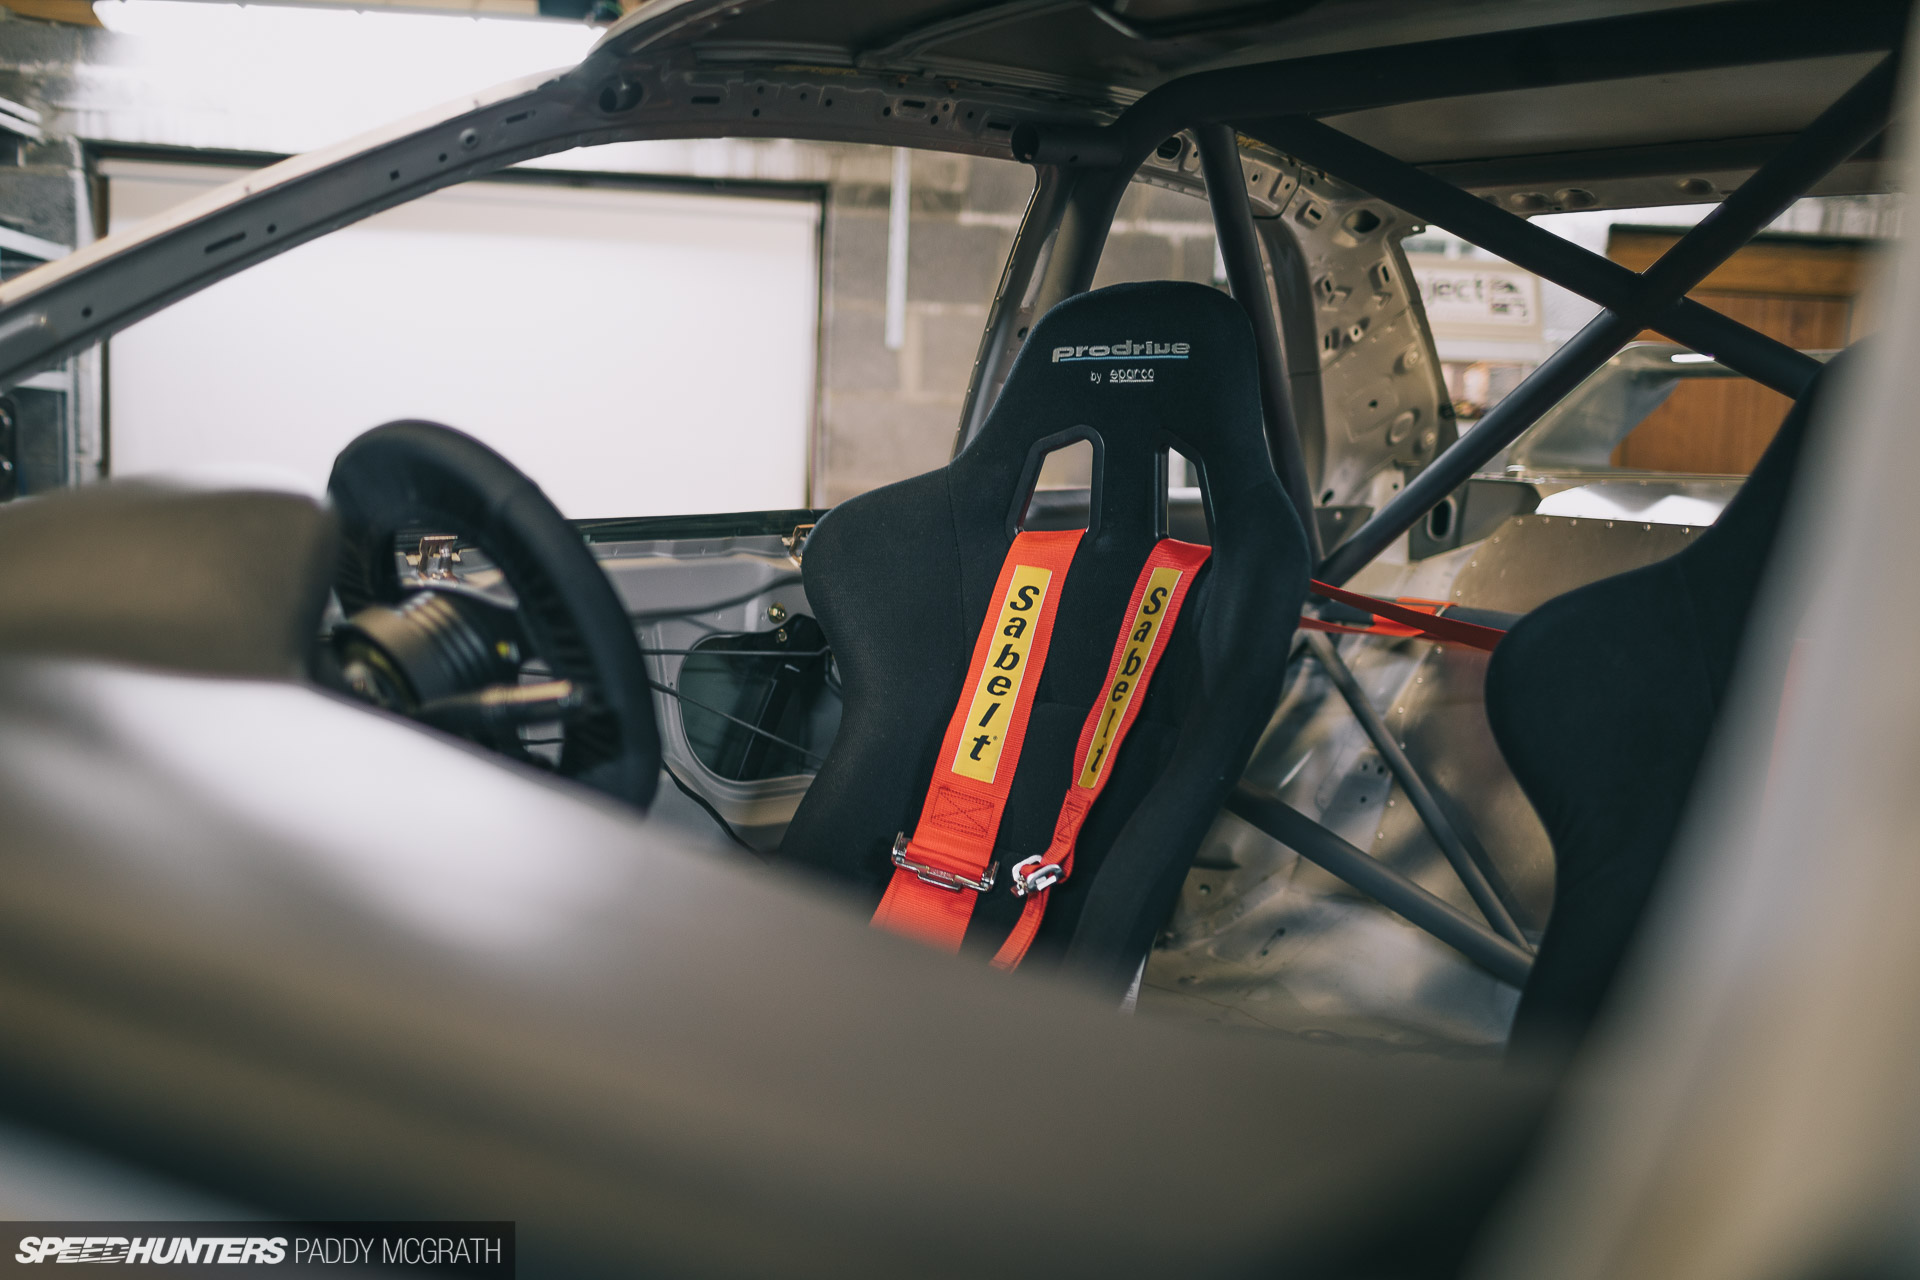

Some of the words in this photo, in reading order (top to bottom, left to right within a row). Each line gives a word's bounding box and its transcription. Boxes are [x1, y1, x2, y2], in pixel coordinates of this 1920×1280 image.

[1052, 340, 1190, 363] prodrive
[1090, 371, 1102, 384] by
[1109, 368, 1155, 384] sparco
[968, 584, 1041, 763] Sabelt
[1089, 586, 1168, 773] Sabelt
